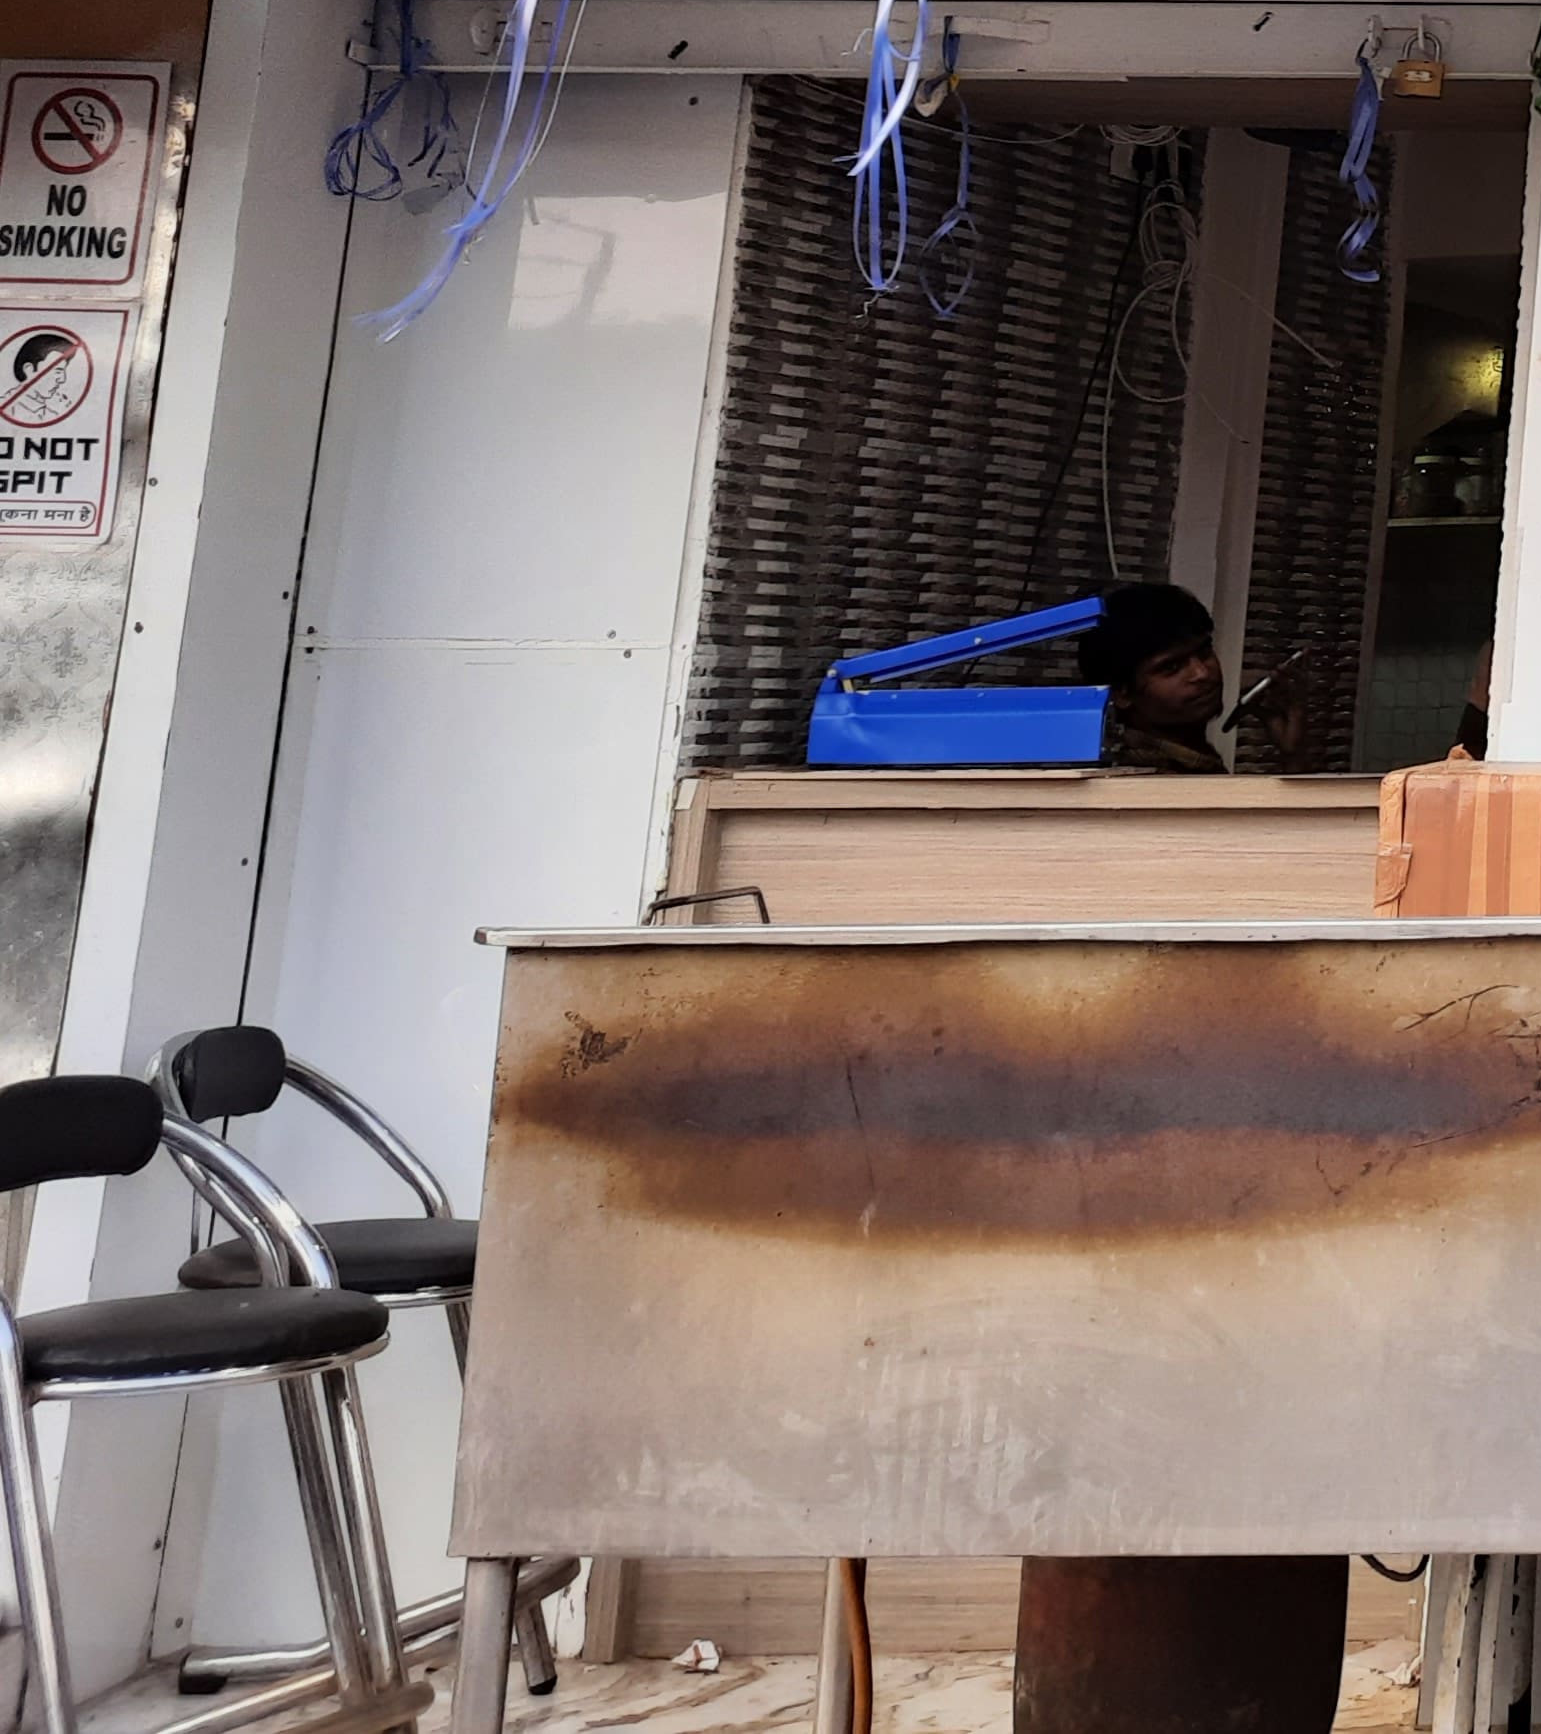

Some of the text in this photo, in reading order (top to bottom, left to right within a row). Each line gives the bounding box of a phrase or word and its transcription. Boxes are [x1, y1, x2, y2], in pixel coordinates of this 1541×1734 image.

[46, 184, 87, 217] NO
[0, 224, 128, 259] SMOKING
[0, 437, 100, 461] O NOT
[43, 509, 75, 522] मना
[79, 505, 92, 523] है
